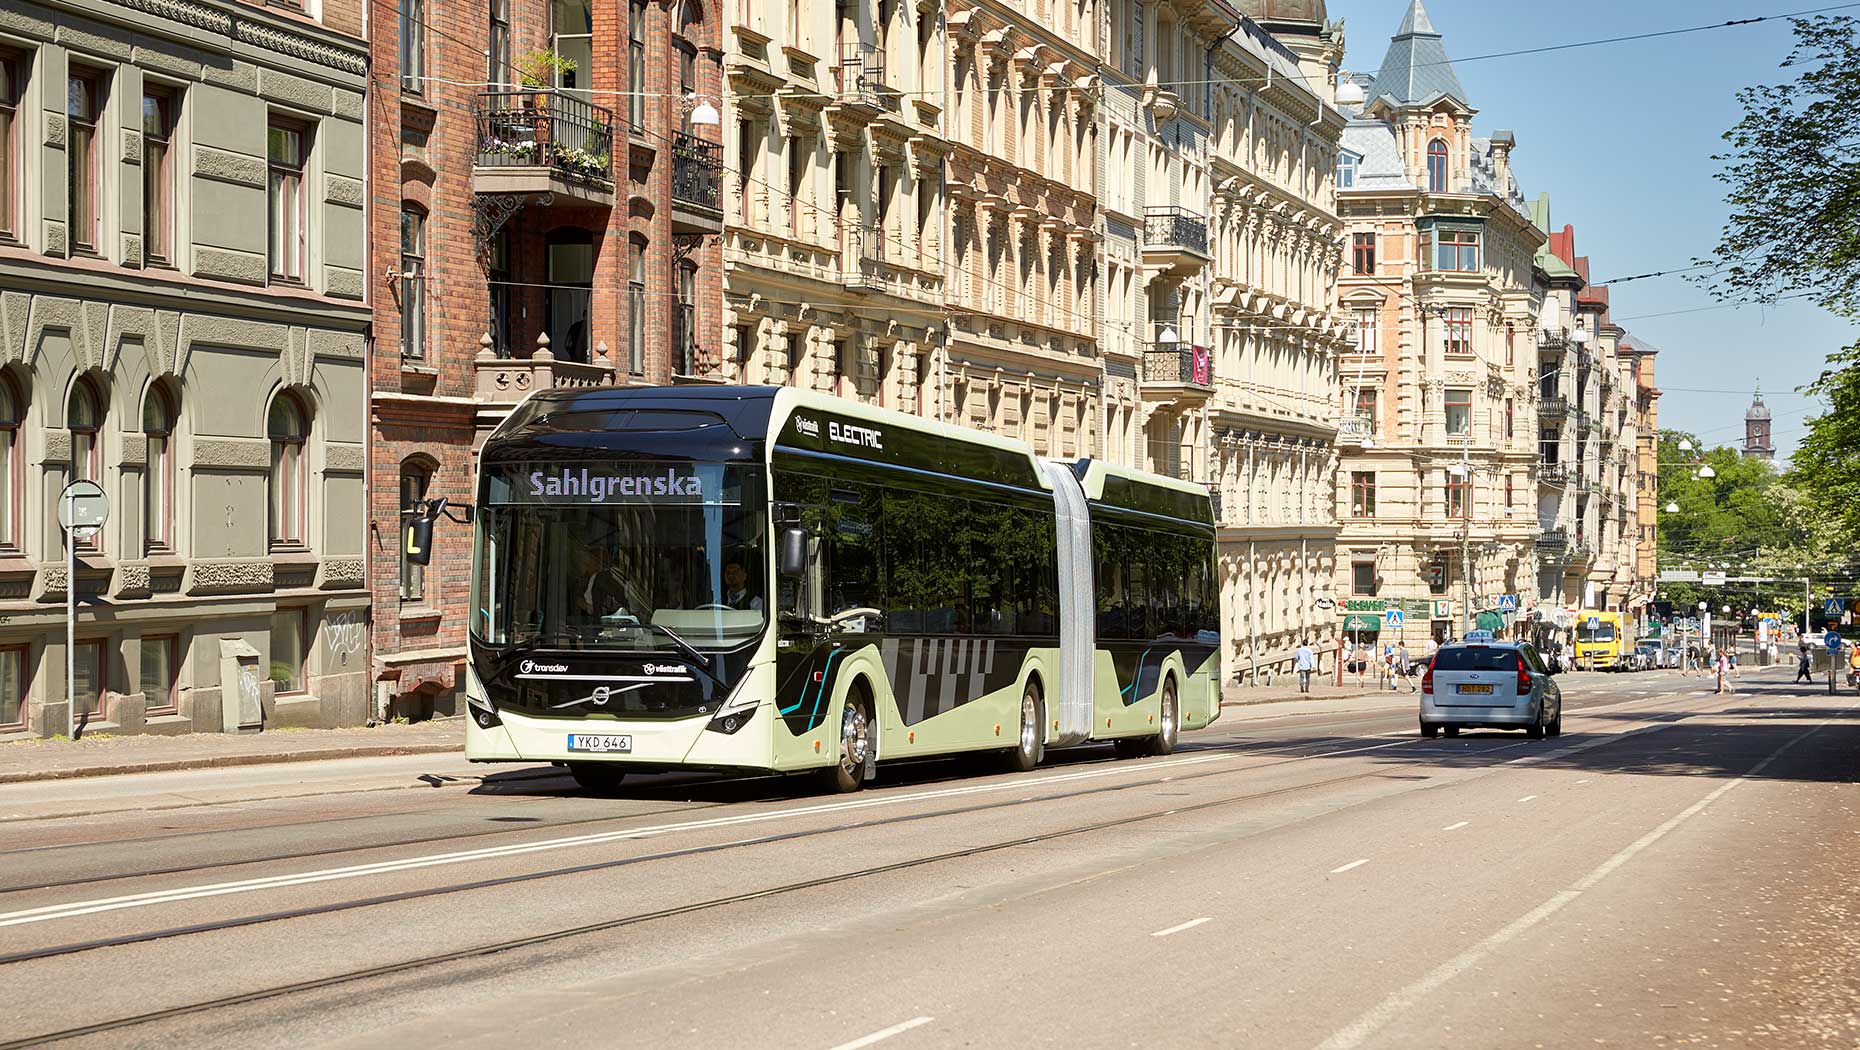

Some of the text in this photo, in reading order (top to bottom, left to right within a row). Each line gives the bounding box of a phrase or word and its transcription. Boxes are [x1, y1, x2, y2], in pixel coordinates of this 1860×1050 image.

[829, 421, 883, 449] ELECTRIC
[529, 468, 703, 502] Sahlgrenska
[534, 663, 568, 672] transdev
[655, 664, 688, 673] västtrafik
[578, 736, 627, 749] YKD 646
